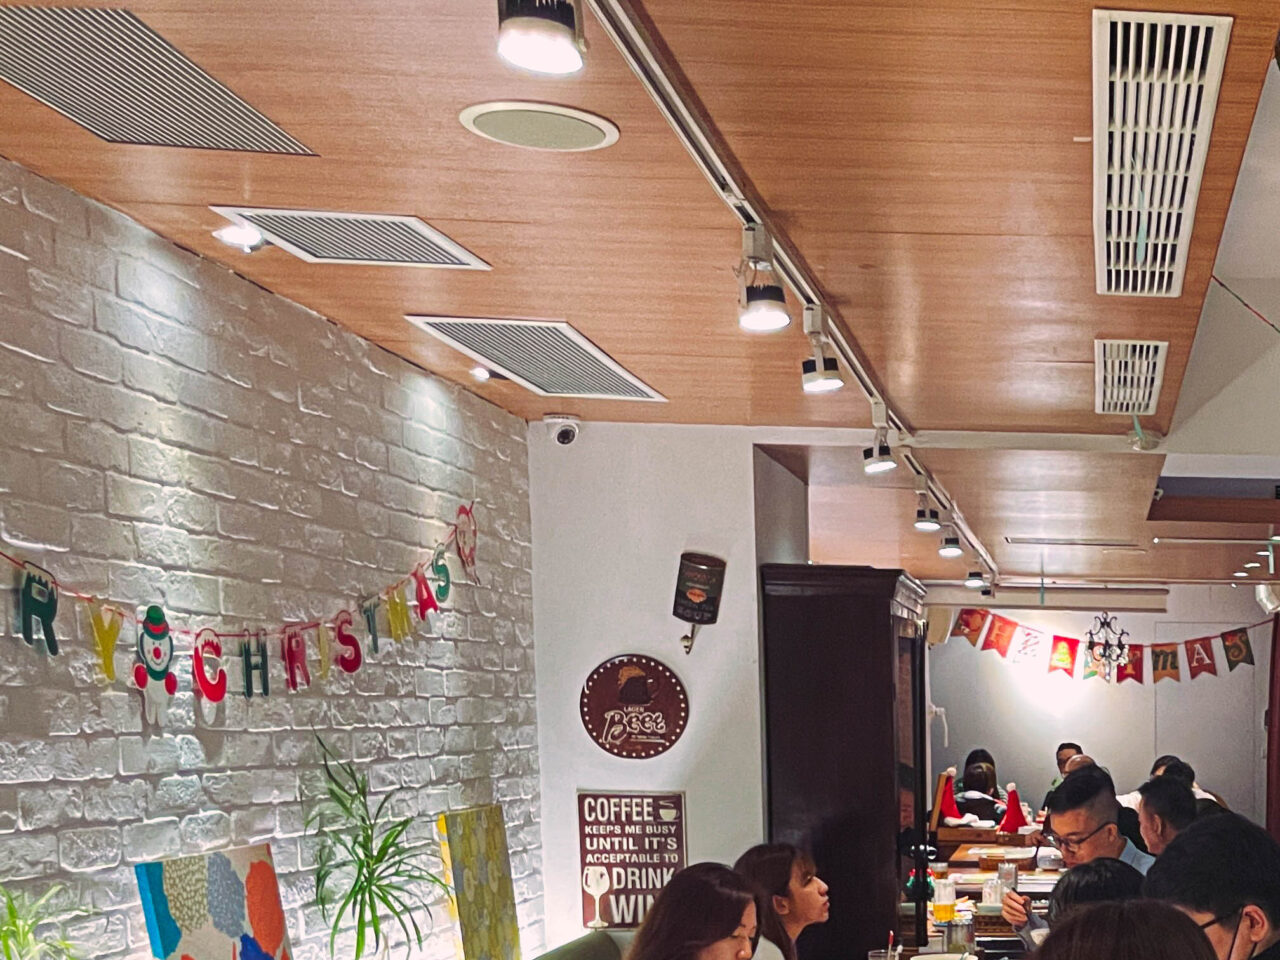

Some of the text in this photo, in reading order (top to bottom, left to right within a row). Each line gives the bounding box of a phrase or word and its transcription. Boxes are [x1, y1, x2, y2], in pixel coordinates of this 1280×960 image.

[584, 797, 653, 822] COFFEE
[584, 825, 676, 834] KEEPS ME BUSY
[585, 837, 677, 850] UNTIL IT'S
[585, 853, 678, 864] ACCEPTABLE TO
